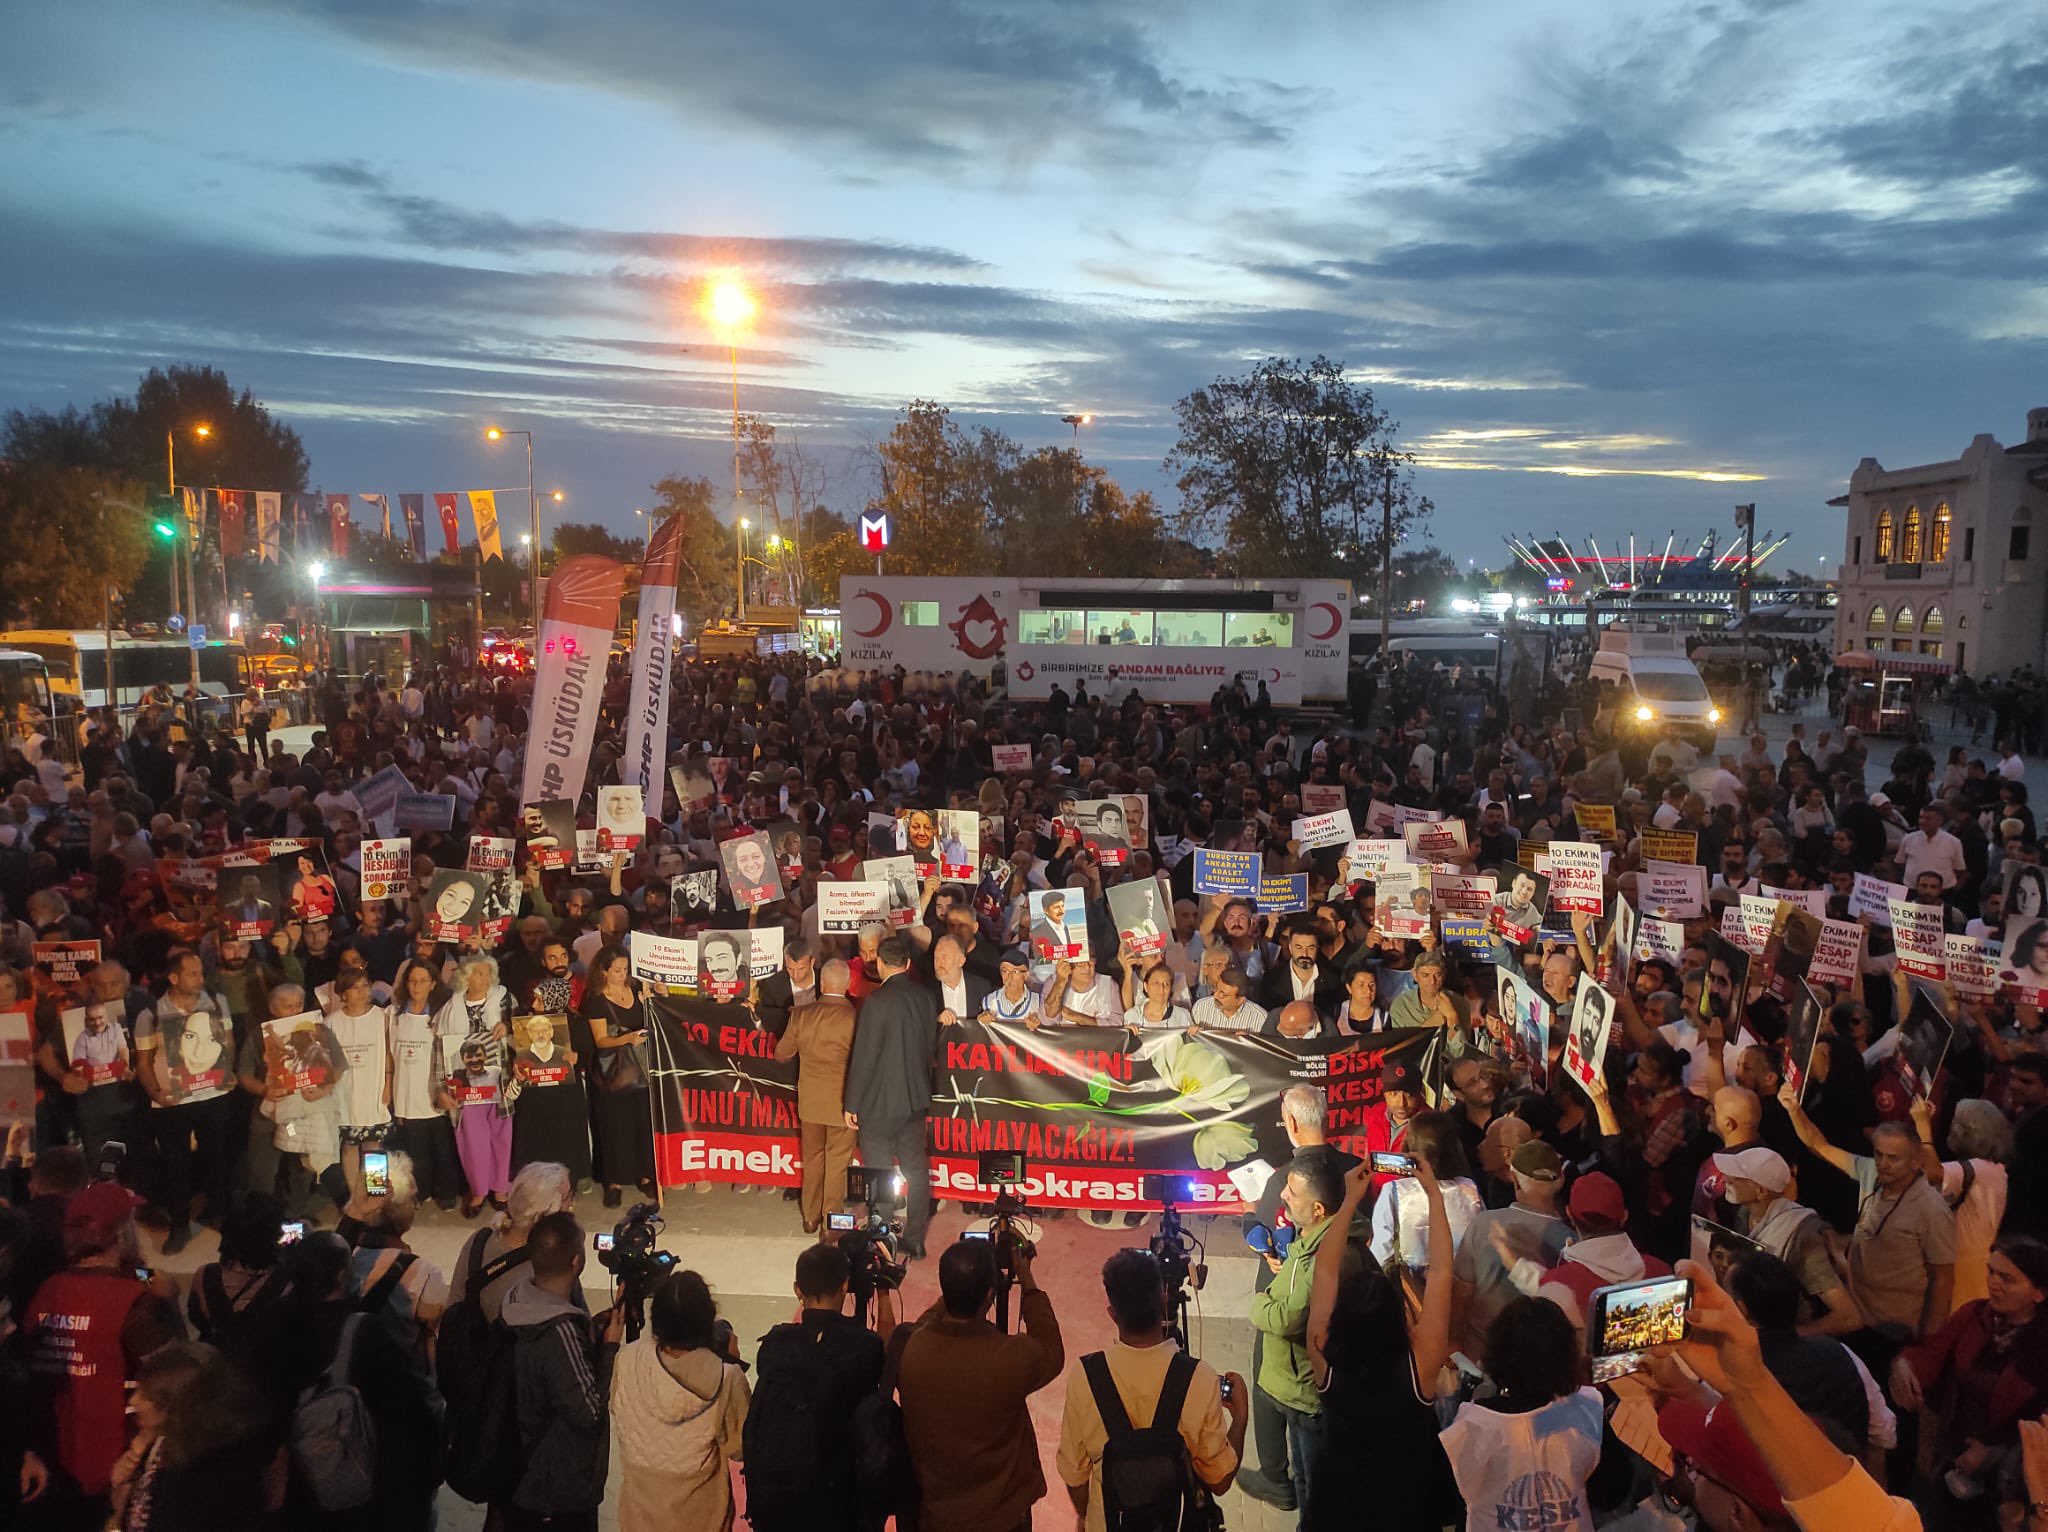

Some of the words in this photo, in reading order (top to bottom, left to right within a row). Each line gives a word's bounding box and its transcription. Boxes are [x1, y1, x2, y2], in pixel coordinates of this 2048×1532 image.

[861, 514, 888, 545] M
[850, 649, 893, 660] KIZILAY
[1304, 649, 1341, 658] KIZILAY
[644, 612, 669, 728] ÜSKÜDAR
[1040, 661, 1104, 673] BİRBİRİMİZE
[1166, 663, 1226, 676] BAĞLIYIZ
[544, 651, 591, 758] ÜSKÜDAR
[540, 762, 566, 800] HP
[1304, 825, 1337, 837] UNUTMA
[1551, 849, 1562, 858] 10
[364, 858, 409, 871] HESABINI
[1205, 860, 1250, 869] ANKARA'YA
[1211, 868, 1243, 876] ADALET
[1557, 869, 1597, 881] HESAP
[387, 883, 405, 894] SEP
[1553, 880, 1600, 893] SORACAĞIZ
[1652, 887, 1686, 895] UNUTMA
[1742, 903, 1752, 912] 10
[1724, 914, 1734, 922] 10
[1897, 927, 1937, 945] HESAP
[1895, 940, 1943, 958] SORACAĞIZ
[1946, 941, 1957, 950] 10
[52, 961, 76, 971] OMUZ
[1951, 962, 1995, 978] HESAP
[51, 971, 81, 981] OMUZA
[665, 974, 698, 983] SODAP
[1949, 973, 1995, 989] SORACAĞI
[681, 1021, 709, 1045] 10
[1328, 1047, 1388, 1076] DİSK
[1289, 1069, 1327, 1077] TEMSİLCİLİĞİ
[929, 1162, 1144, 1201] deokrasi
[1496, 1497, 1581, 1532] KESK
